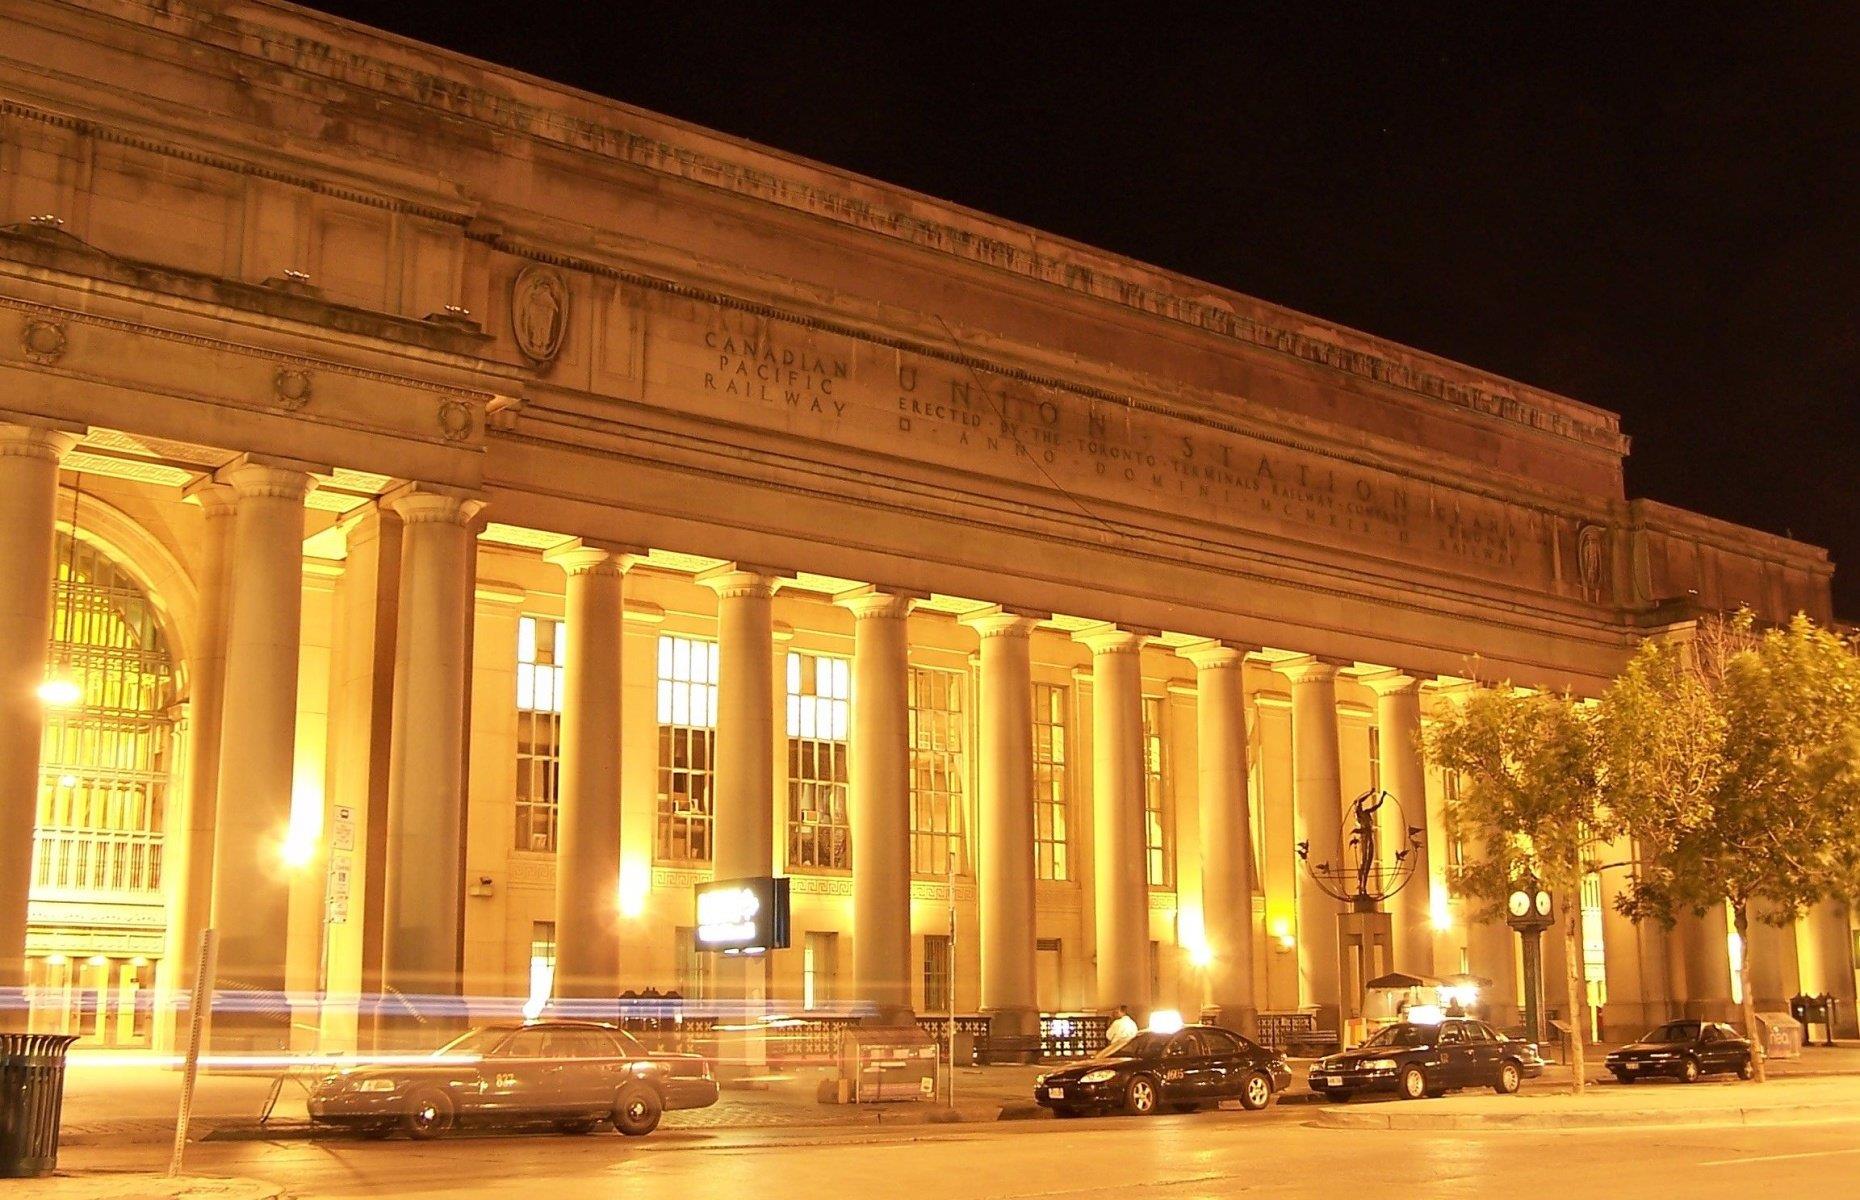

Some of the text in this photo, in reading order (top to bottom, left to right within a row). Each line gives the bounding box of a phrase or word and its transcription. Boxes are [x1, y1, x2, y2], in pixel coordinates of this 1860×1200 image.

[705, 331, 846, 377] CANADIAN
[720, 355, 832, 395] PACIFIC
[704, 371, 845, 417] RAILWAY
[899, 366, 1408, 508] UNION STATION
[899, 396, 981, 427] ERECTED
[1077, 438, 1155, 466] TORONTO
[1172, 460, 1259, 491] TERMINALS
[960, 431, 1054, 463] ANNO
[1096, 462, 1229, 502] DOMINI
